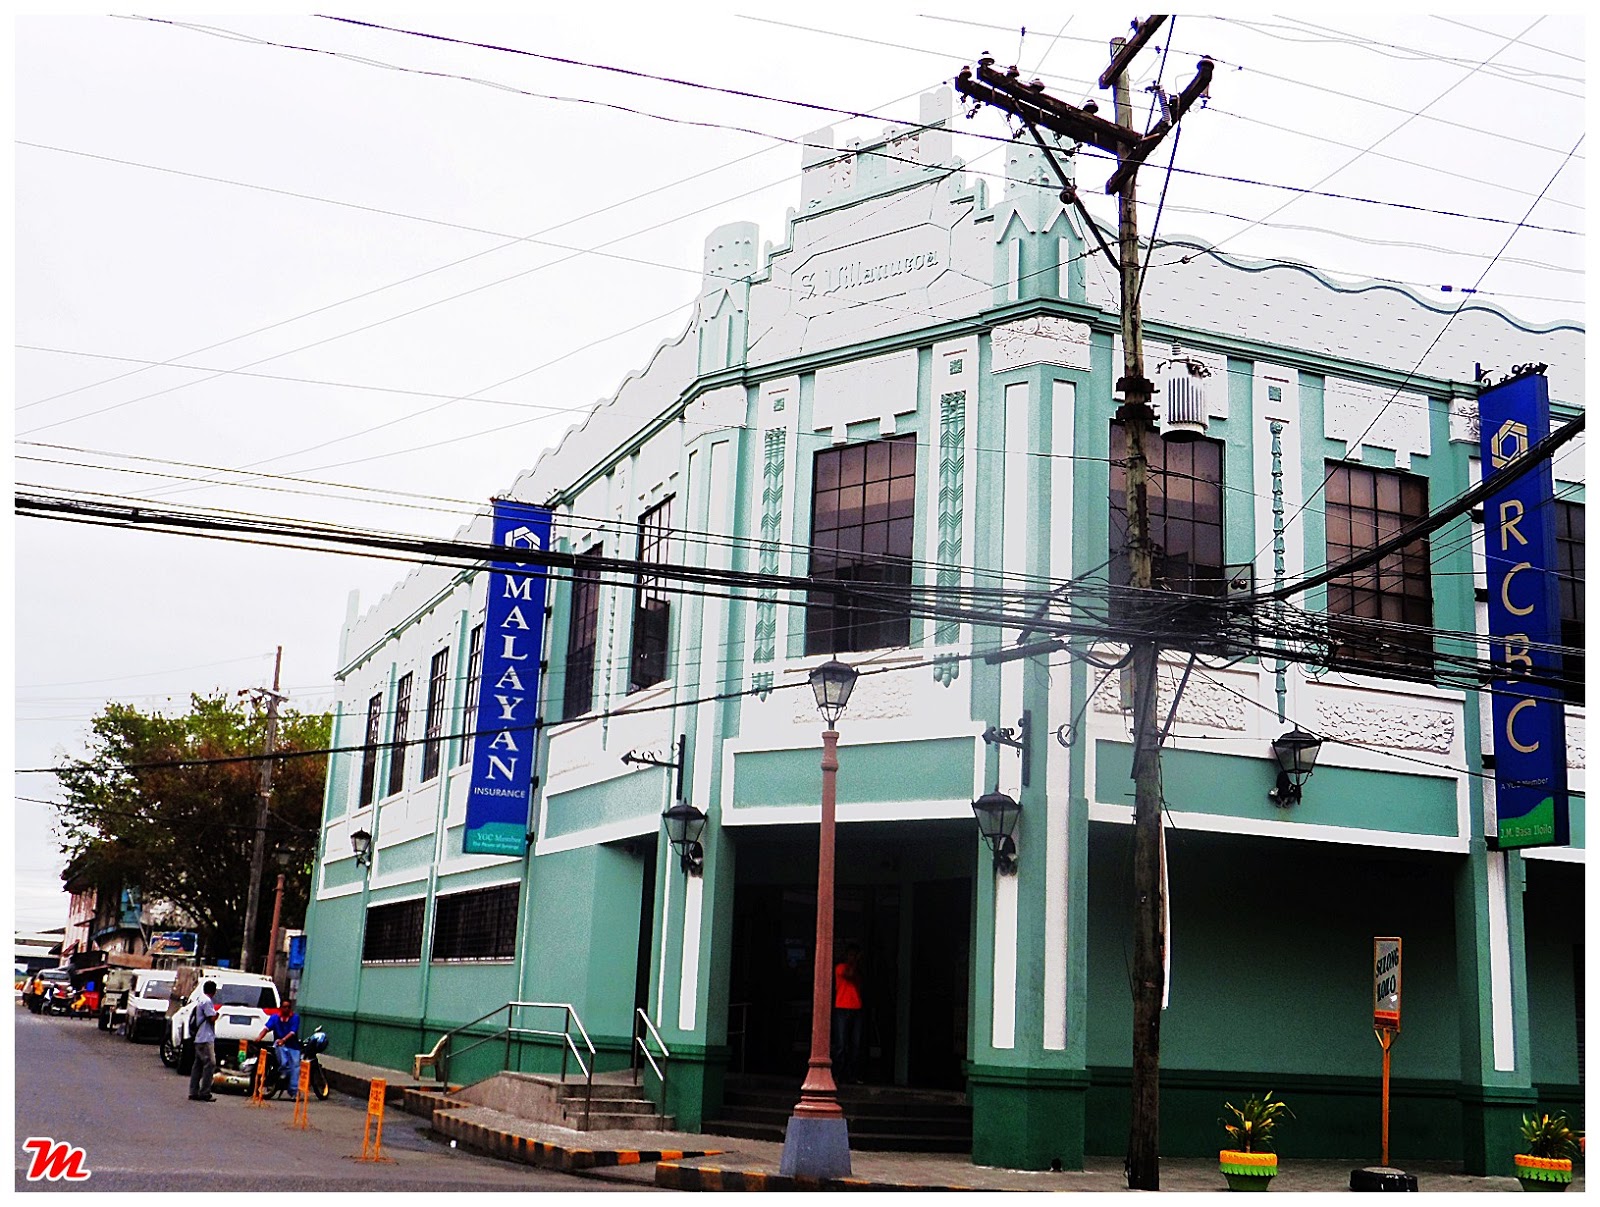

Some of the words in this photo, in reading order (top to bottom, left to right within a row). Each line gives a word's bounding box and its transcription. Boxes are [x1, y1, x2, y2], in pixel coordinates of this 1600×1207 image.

[484, 574, 534, 782] MALAYAN
[1499, 499, 1540, 754] RCBC
[474, 787, 526, 799] INSURANCE
